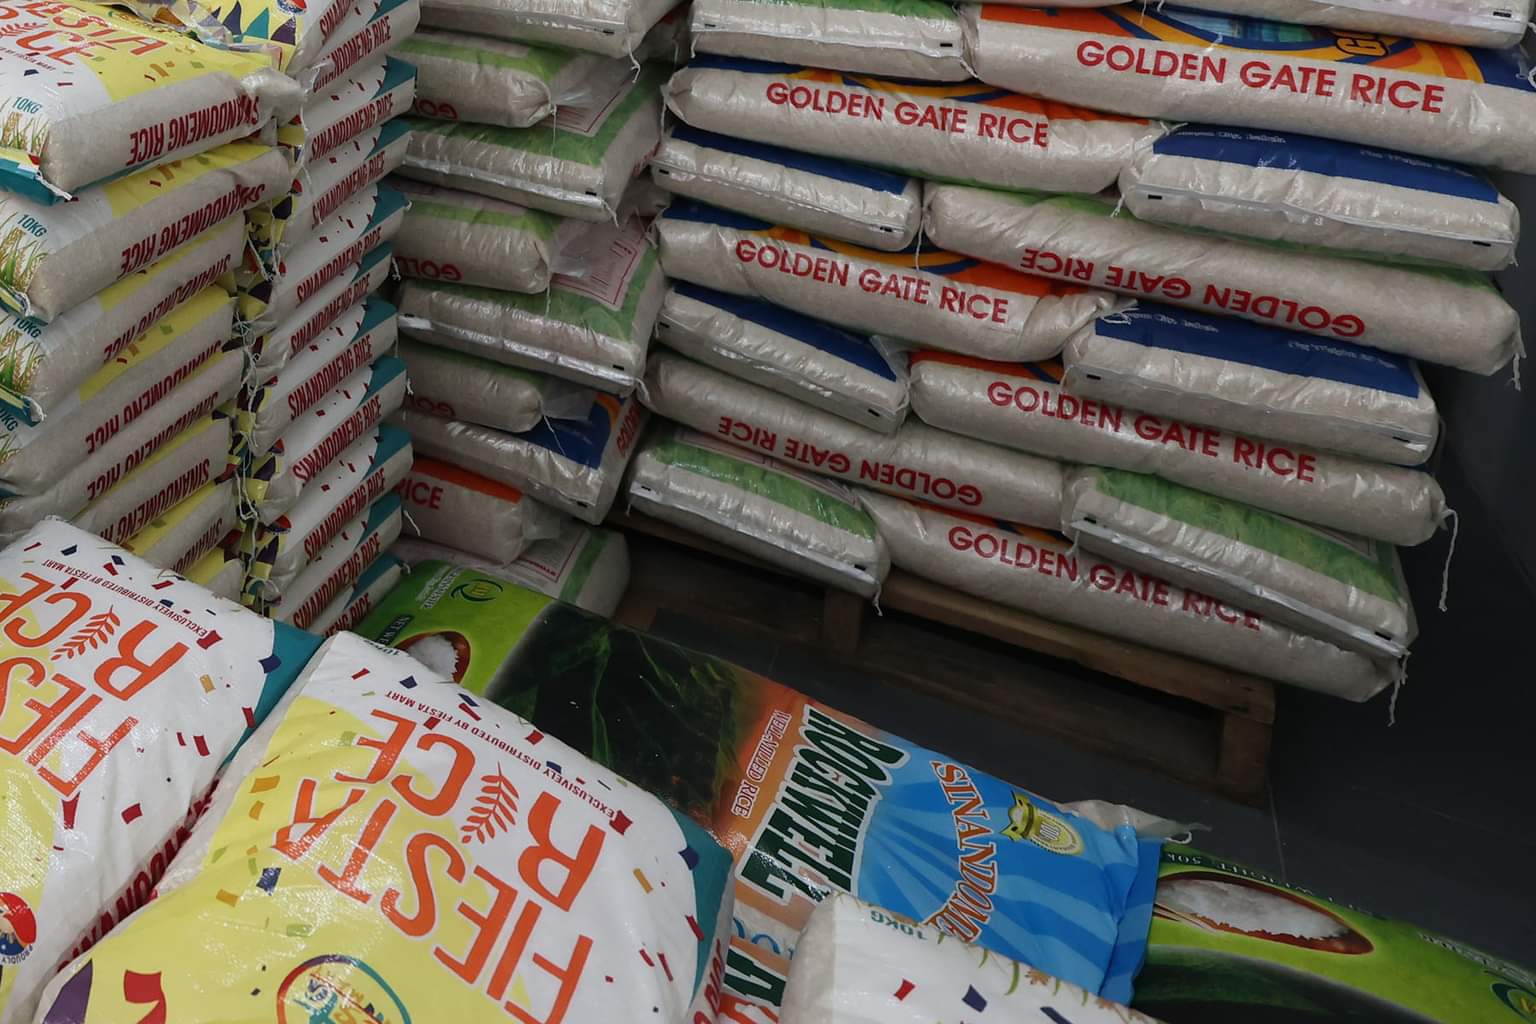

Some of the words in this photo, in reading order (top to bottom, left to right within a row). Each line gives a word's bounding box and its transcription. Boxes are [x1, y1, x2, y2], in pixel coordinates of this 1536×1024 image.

[1076, 40, 1226, 83] GOLDEN
[1239, 61, 1336, 98] GATE
[1349, 75, 1445, 115] RICE
[11, 95, 42, 115] 10KG
[374, 91, 395, 124] RICE
[765, 82, 885, 122] GOLDEN
[893, 99, 967, 135] GATE
[977, 114, 1050, 149] RICE
[126, 123, 166, 166] RICE
[16, 212, 49, 239] 10KG
[1019, 246, 1096, 281] RICE
[734, 238, 851, 288] GOLDEN
[858, 269, 932, 308] GATE
[939, 287, 1010, 325] RICE
[1105, 264, 1192, 300] GATE
[1202, 283, 1365, 337] GOLDEN
[354, 334, 374, 364] RICE
[363, 393, 382, 426] RICE
[718, 414, 776, 453] RICE
[987, 380, 1123, 433] GOLDEN
[1131, 413, 1221, 458] GATE
[1231, 437, 1317, 484] RICE
[783, 437, 852, 477] GATE
[363, 468, 387, 503] RICE
[859, 459, 983, 508] GOLDEN
[41, 559, 66, 572] MART
[360, 532, 381, 566] RICE
[64, 565, 93, 582] FIESTA
[90, 575, 102, 585] BY
[948, 526, 1080, 579] GOLDEN
[1089, 563, 1170, 609] GATE
[101, 578, 155, 608] DISTRIBUTED
[154, 602, 208, 638] EXCLUSIVELY
[385, 691, 417, 709] MART
[416, 704, 454, 724] FIESTA
[454, 719, 471, 731] BY
[470, 725, 542, 771] DISTRIBUTED
[542, 766, 616, 820] EXCLUSIVELY
[730, 776, 759, 820] RICE
[272, 777, 594, 1024] FIESTA
[868, 910, 928, 942] 10KG
